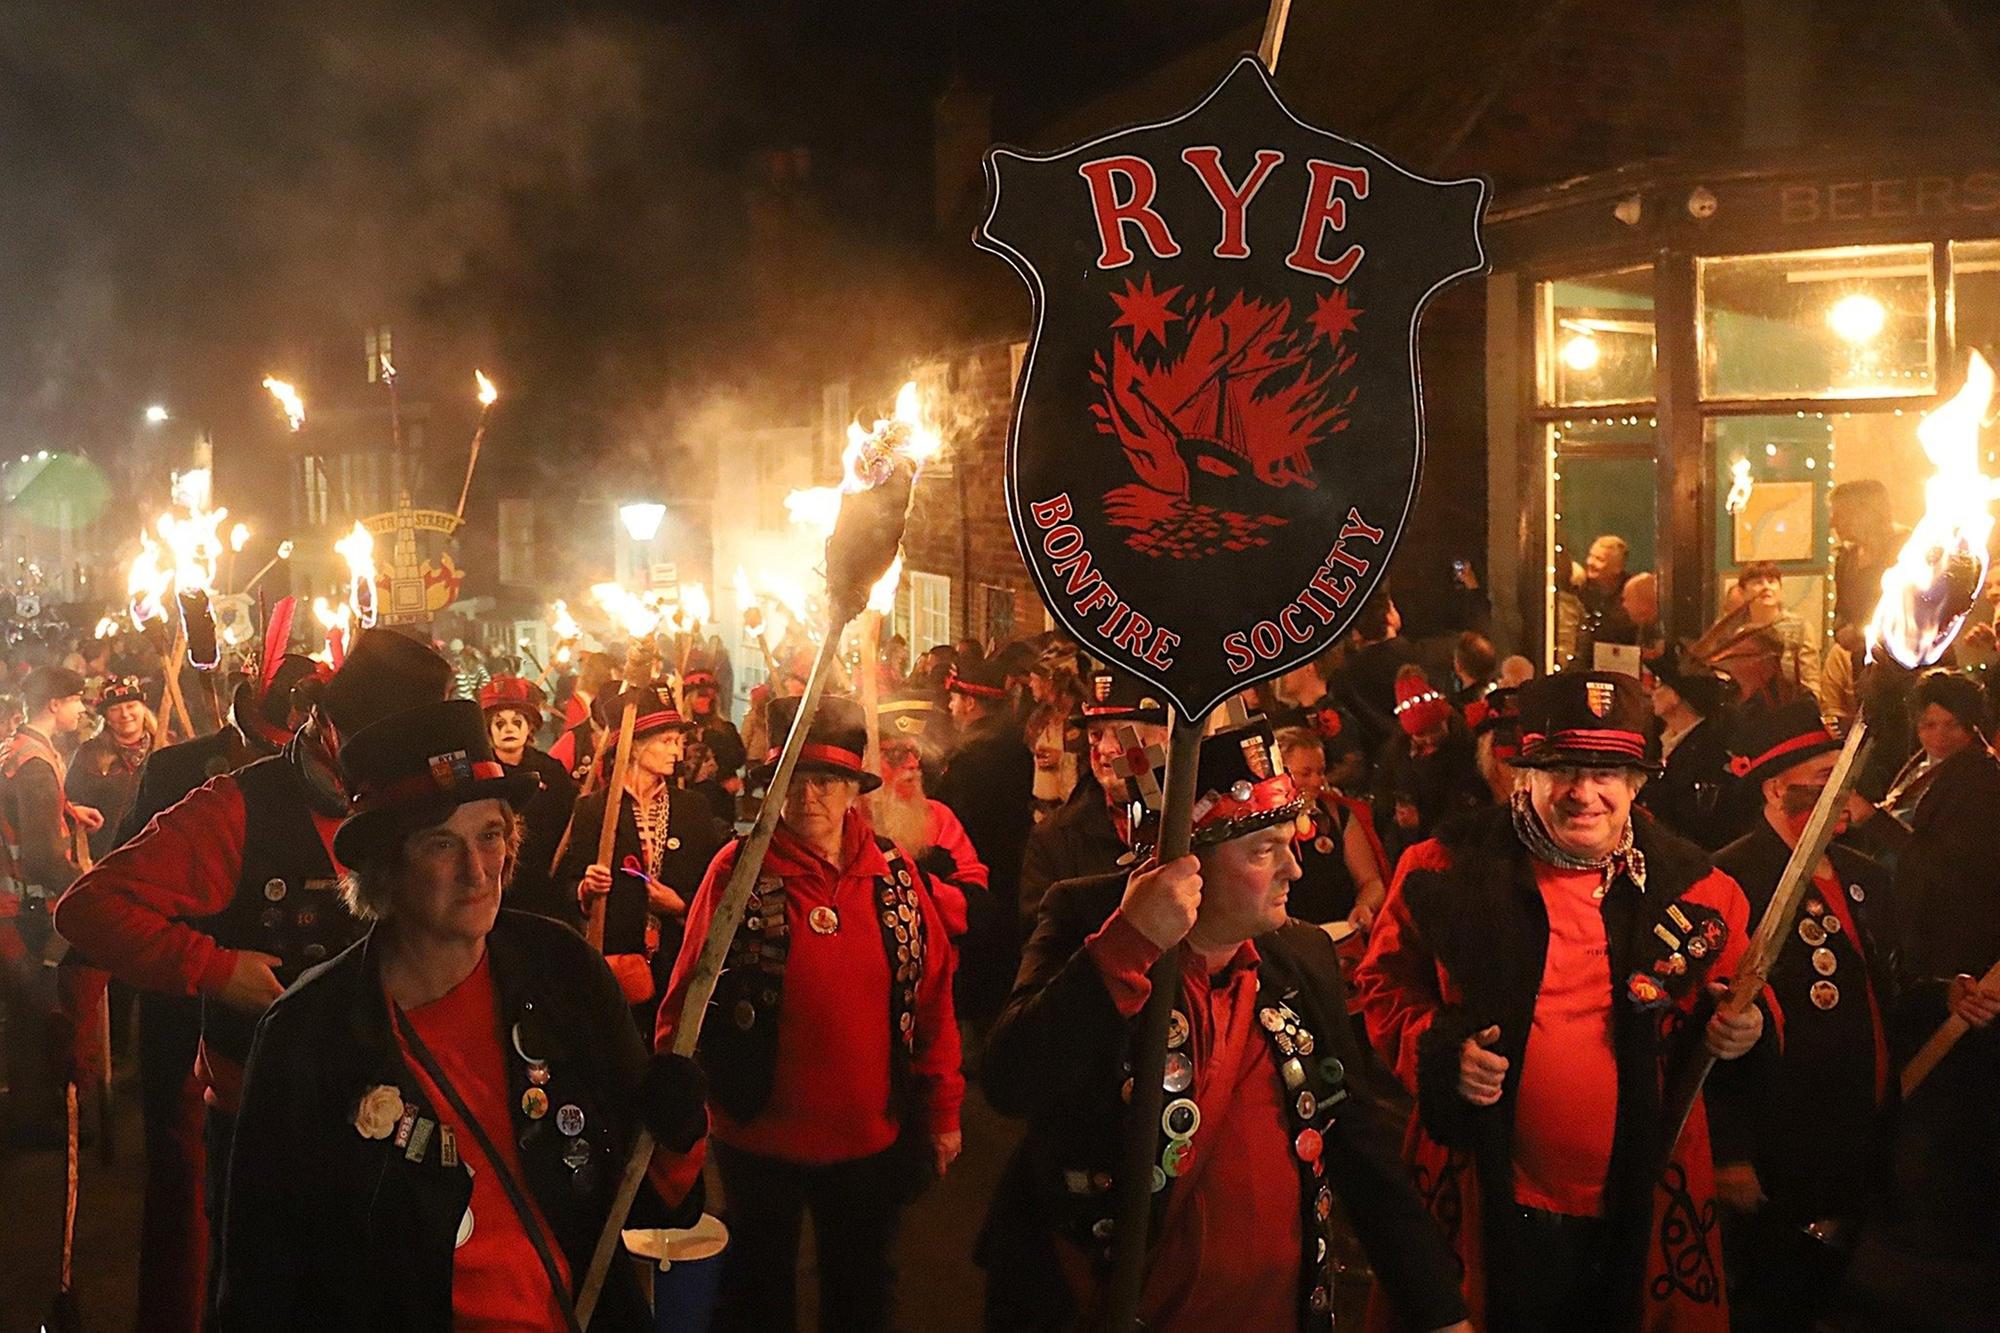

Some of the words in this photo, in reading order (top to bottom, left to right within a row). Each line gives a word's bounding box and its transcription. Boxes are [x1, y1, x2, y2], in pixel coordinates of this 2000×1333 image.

[1078, 146, 1369, 283] RYE
[1781, 173, 2000, 223] BEERS
[1030, 492, 1181, 671] BONFIRE
[1222, 507, 1384, 674] SOCIETY
